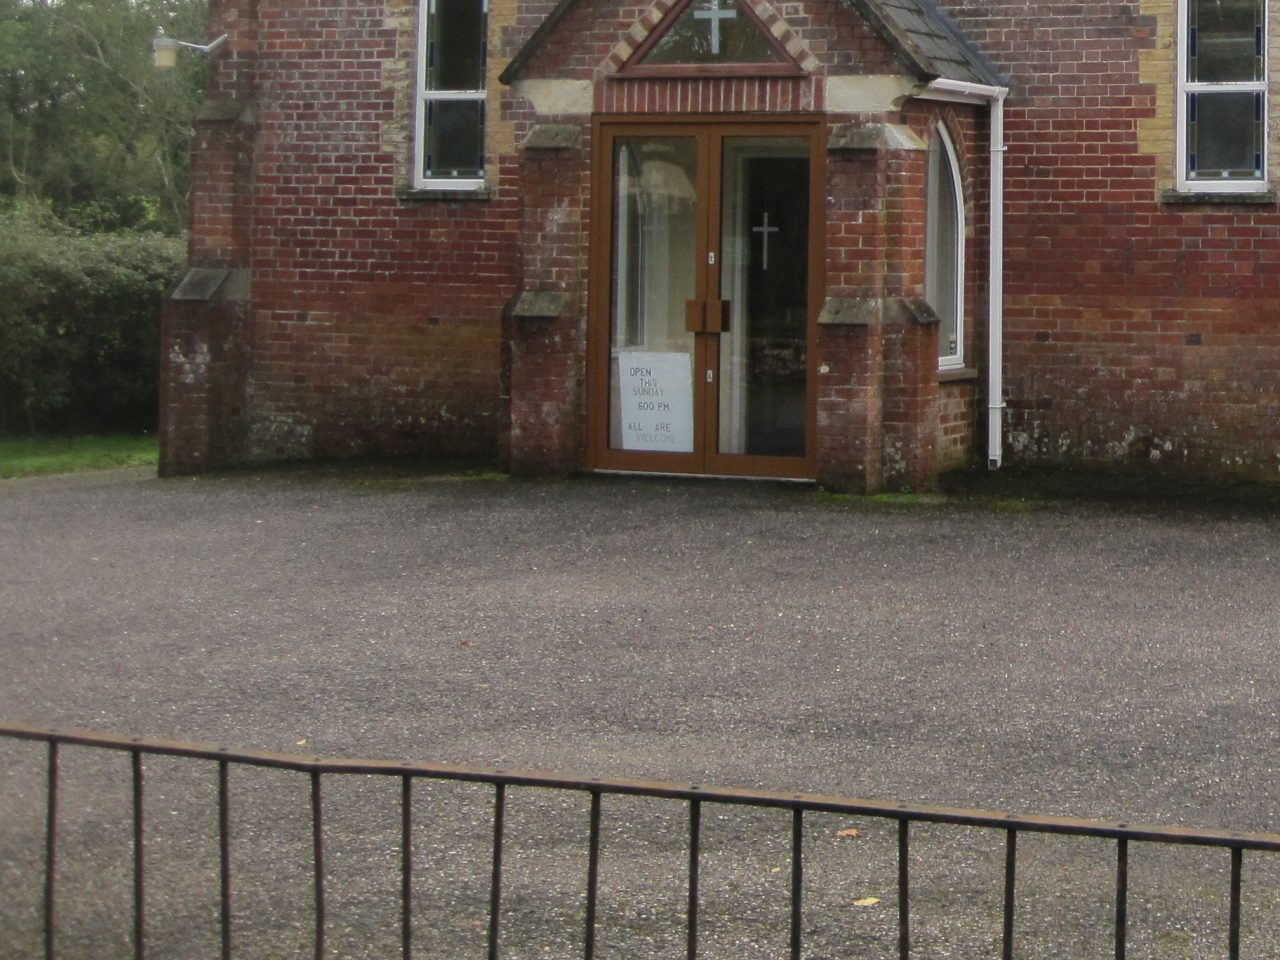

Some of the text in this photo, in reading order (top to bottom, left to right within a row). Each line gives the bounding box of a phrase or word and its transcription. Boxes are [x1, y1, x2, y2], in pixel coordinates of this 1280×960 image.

[629, 367, 652, 377] OPEN
[640, 377, 657, 387] THIS
[632, 387, 664, 397] SUNDAY
[628, 422, 671, 433] ALL ARE
[636, 432, 677, 444] WELCOME
